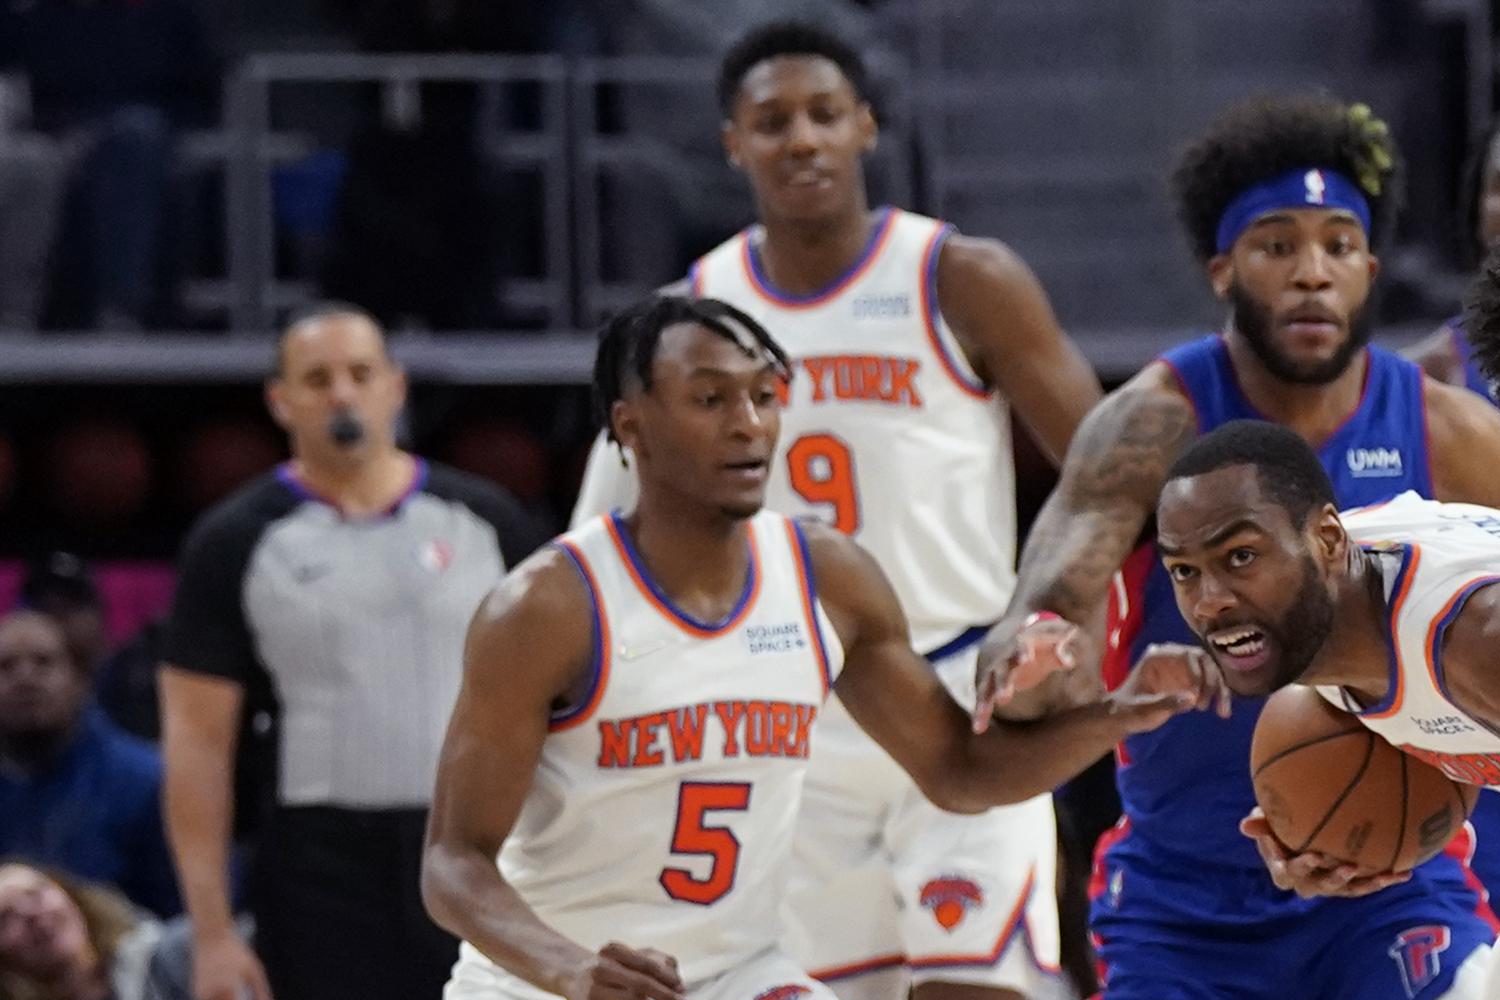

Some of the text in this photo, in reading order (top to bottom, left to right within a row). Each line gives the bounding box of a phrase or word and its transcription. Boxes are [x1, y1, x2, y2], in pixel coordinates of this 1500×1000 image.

[803, 354, 924, 409] YORK
[786, 433, 862, 537] 9
[1346, 446, 1403, 473] UWM
[597, 699, 817, 768] NEW YORK
[659, 781, 753, 906] 5
